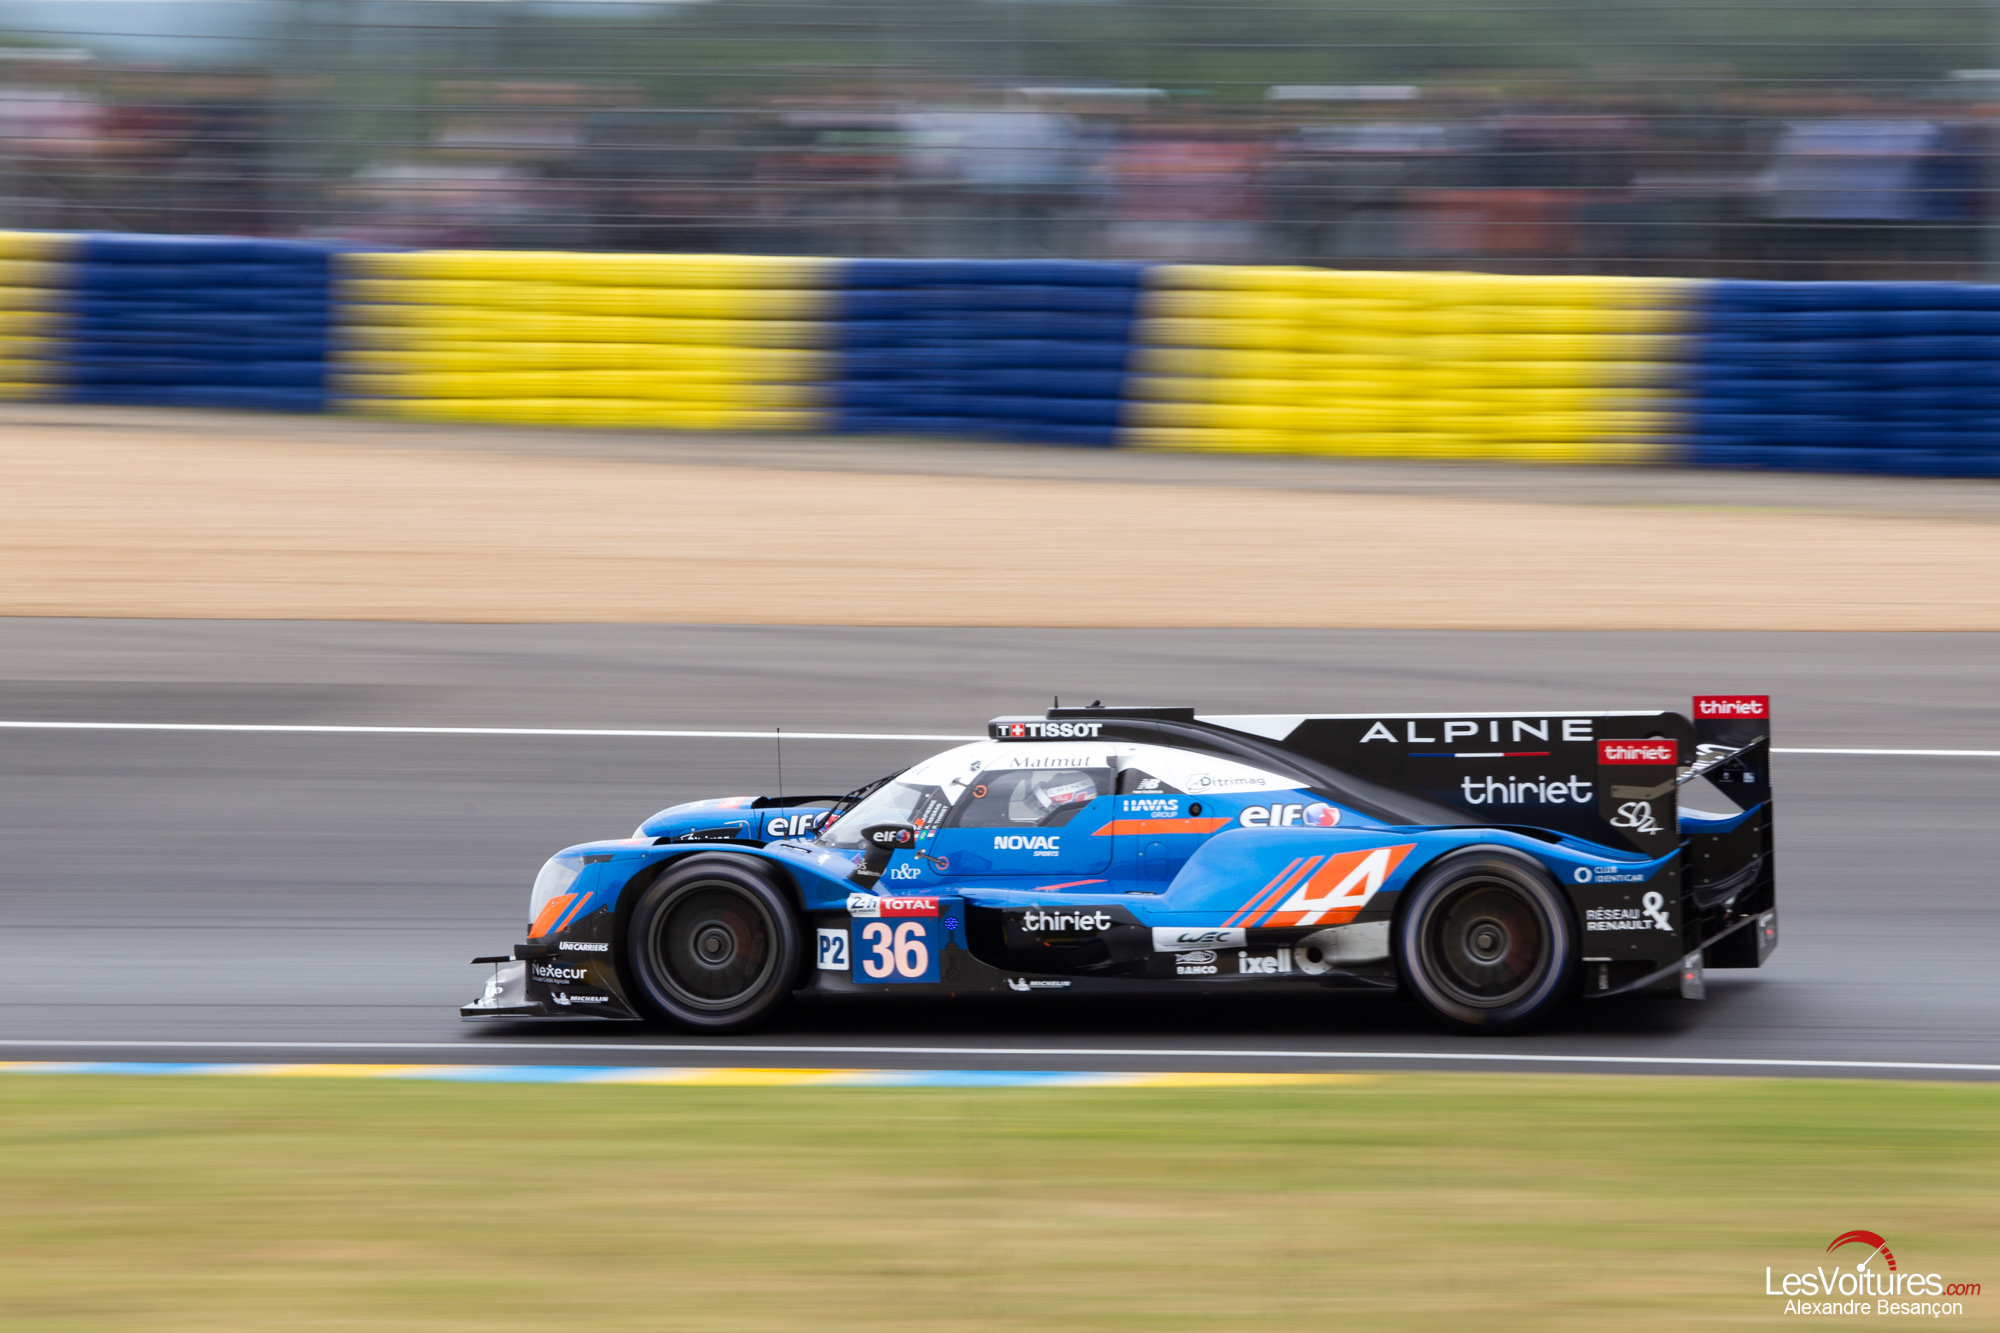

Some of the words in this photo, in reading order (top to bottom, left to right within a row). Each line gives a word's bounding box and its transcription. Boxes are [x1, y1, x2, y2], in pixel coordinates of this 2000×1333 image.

[1699, 700, 1763, 714] thiriet
[1025, 723, 1102, 737] TISSOT
[1359, 719, 1594, 743] ALPINE
[1604, 745, 1672, 760] thiriet
[1010, 757, 1090, 768] Matmut
[1200, 776, 1266, 788] Ditrimag
[1461, 775, 1593, 804] thiriet
[1123, 799, 1179, 811] HAVAS
[1239, 803, 1302, 826] elf
[767, 814, 814, 837] elf
[873, 830, 896, 842] elf
[994, 836, 1060, 850] NOVAC
[891, 863, 921, 880] D&P
[1594, 866, 1618, 874] CLUB
[882, 899, 936, 910] TOTAL
[1022, 911, 1111, 931] thiriet
[1587, 920, 1654, 931] RENAULT
[559, 942, 608, 951] UNICARRIERS
[820, 935, 845, 964] P2
[862, 921, 928, 978] 36
[1238, 949, 1292, 973] ixell
[532, 963, 587, 979] Nexecur
[1176, 966, 1218, 975] BAHCO
